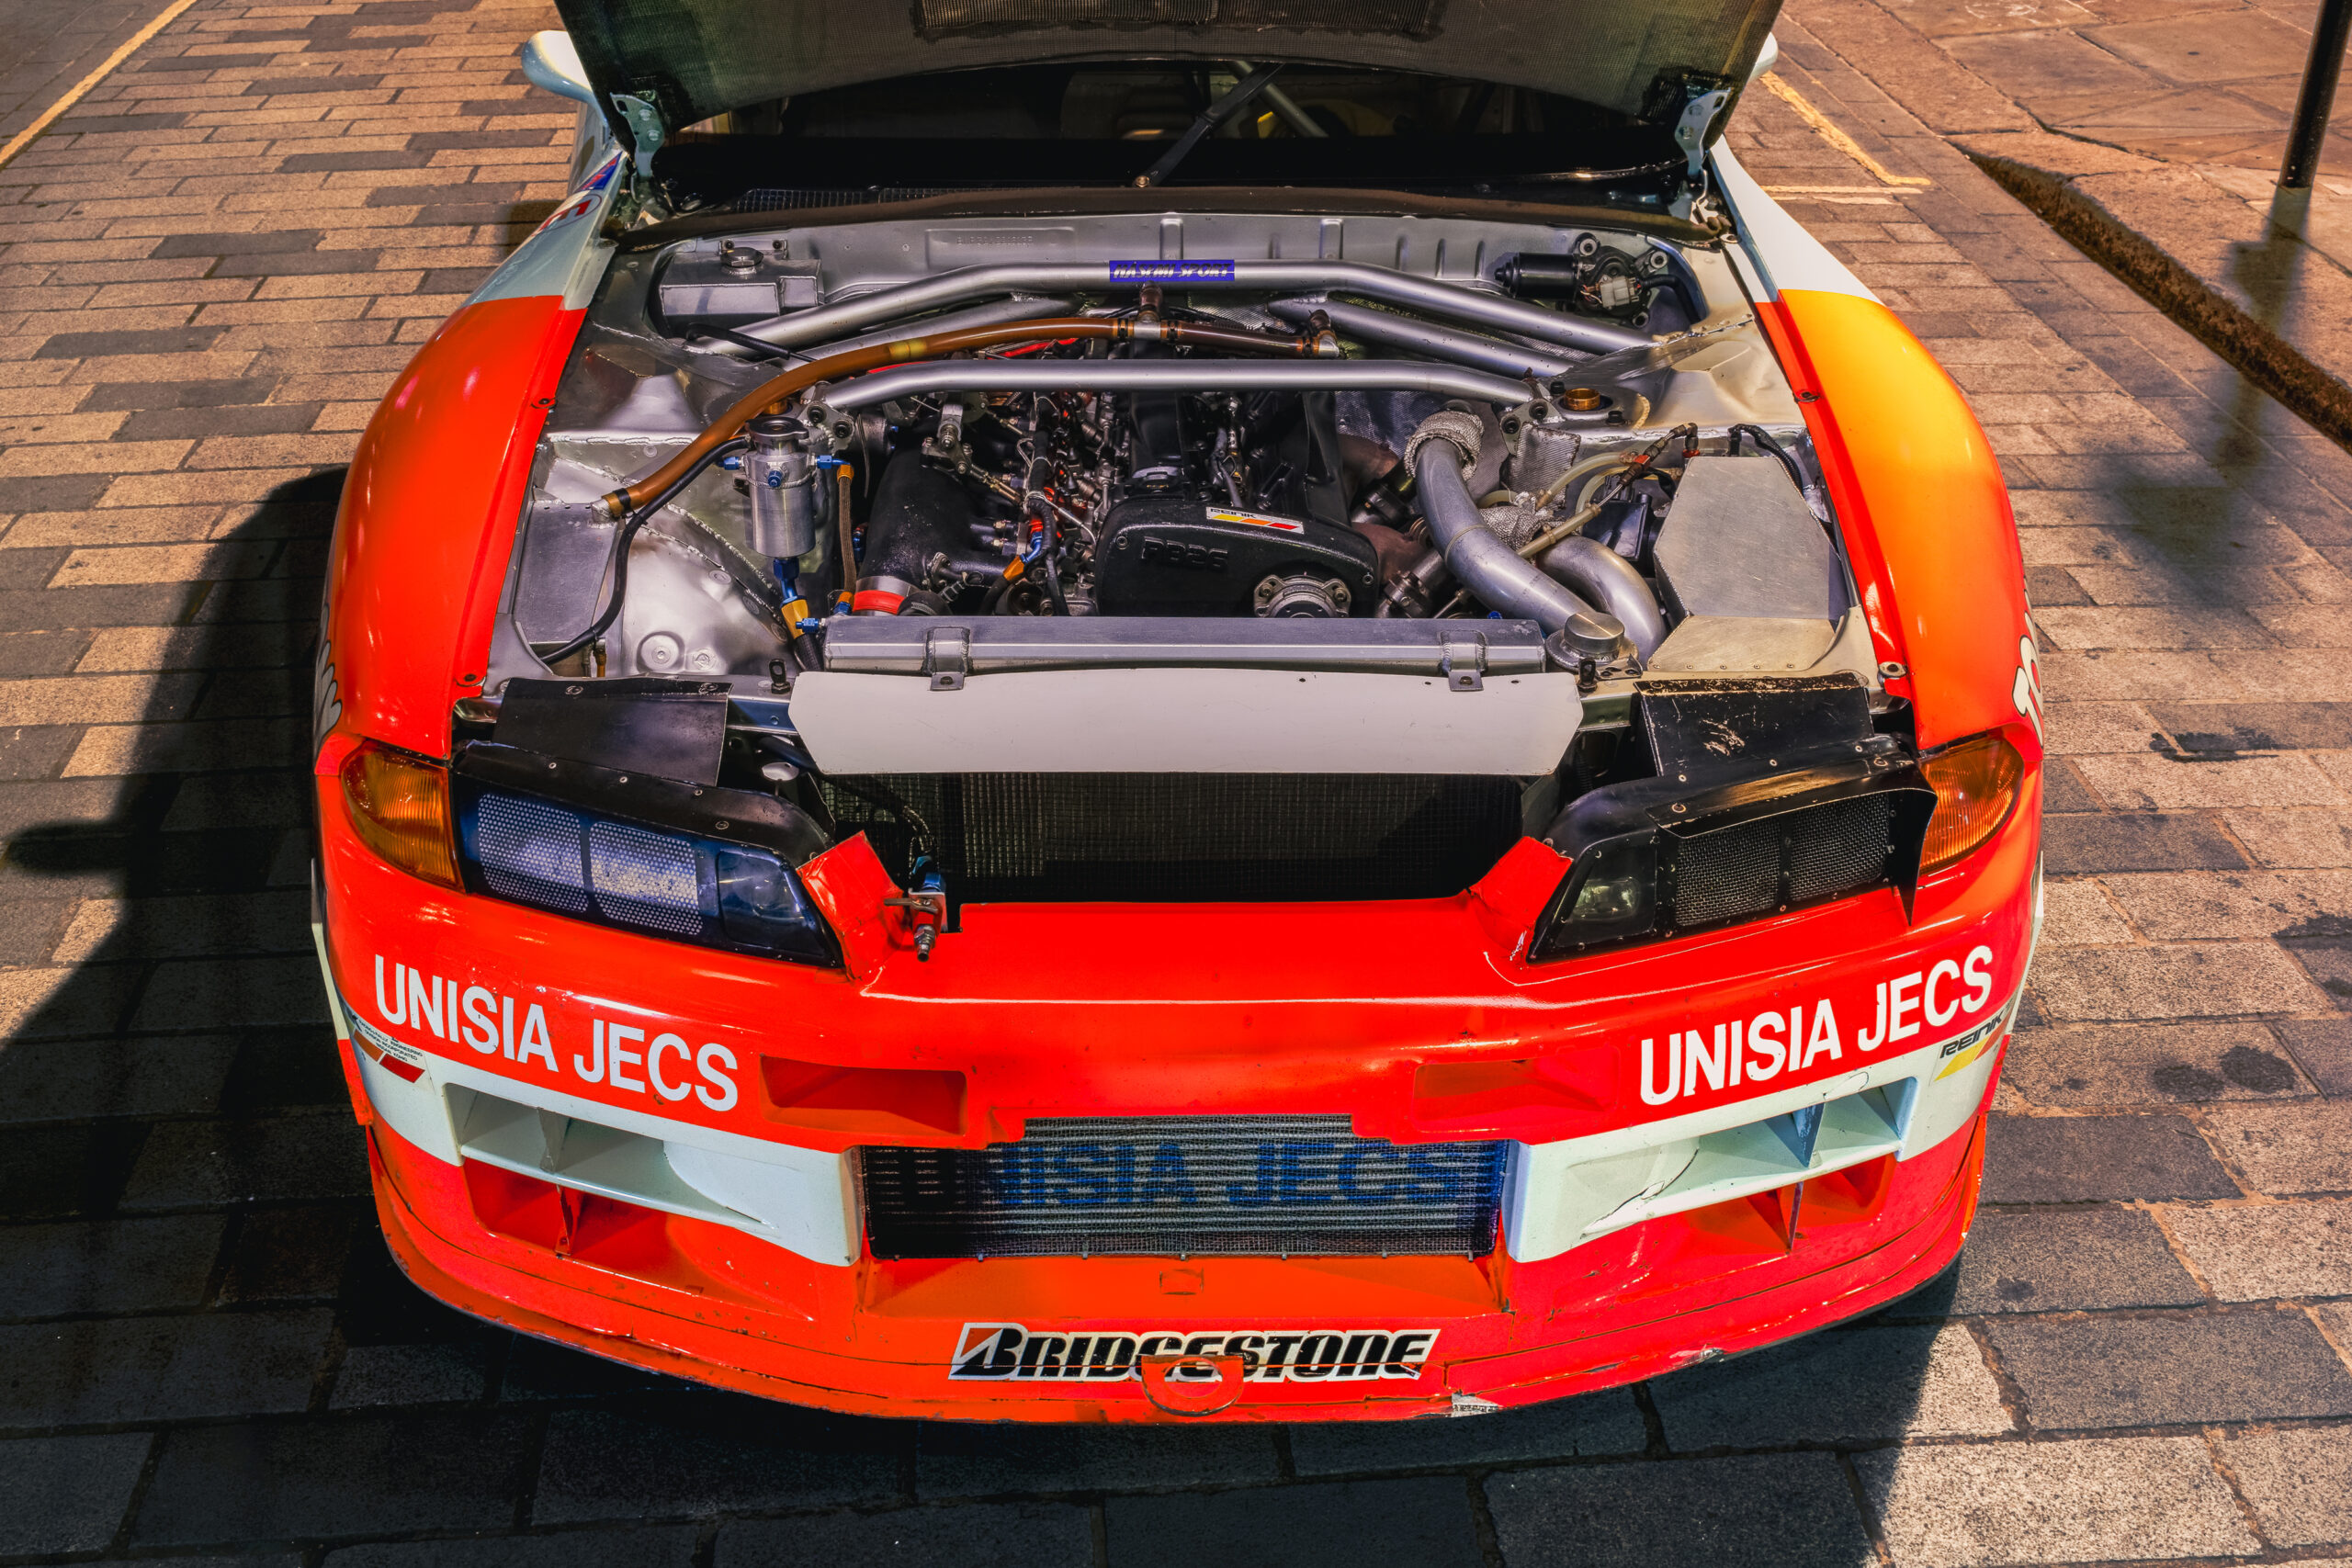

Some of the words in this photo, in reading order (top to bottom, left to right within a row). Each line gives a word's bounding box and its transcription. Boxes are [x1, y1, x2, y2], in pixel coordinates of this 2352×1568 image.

[1114, 263, 1175, 277] HASEMI
[1179, 263, 1232, 277] SPORT
[1141, 536, 1228, 569] RB26
[375, 953, 560, 1073] UNISIA
[573, 1019, 739, 1112] JECS
[1640, 998, 1843, 1106] UNISIA
[1857, 944, 1994, 1053] JECS
[1939, 1010, 2005, 1059] REINIK
